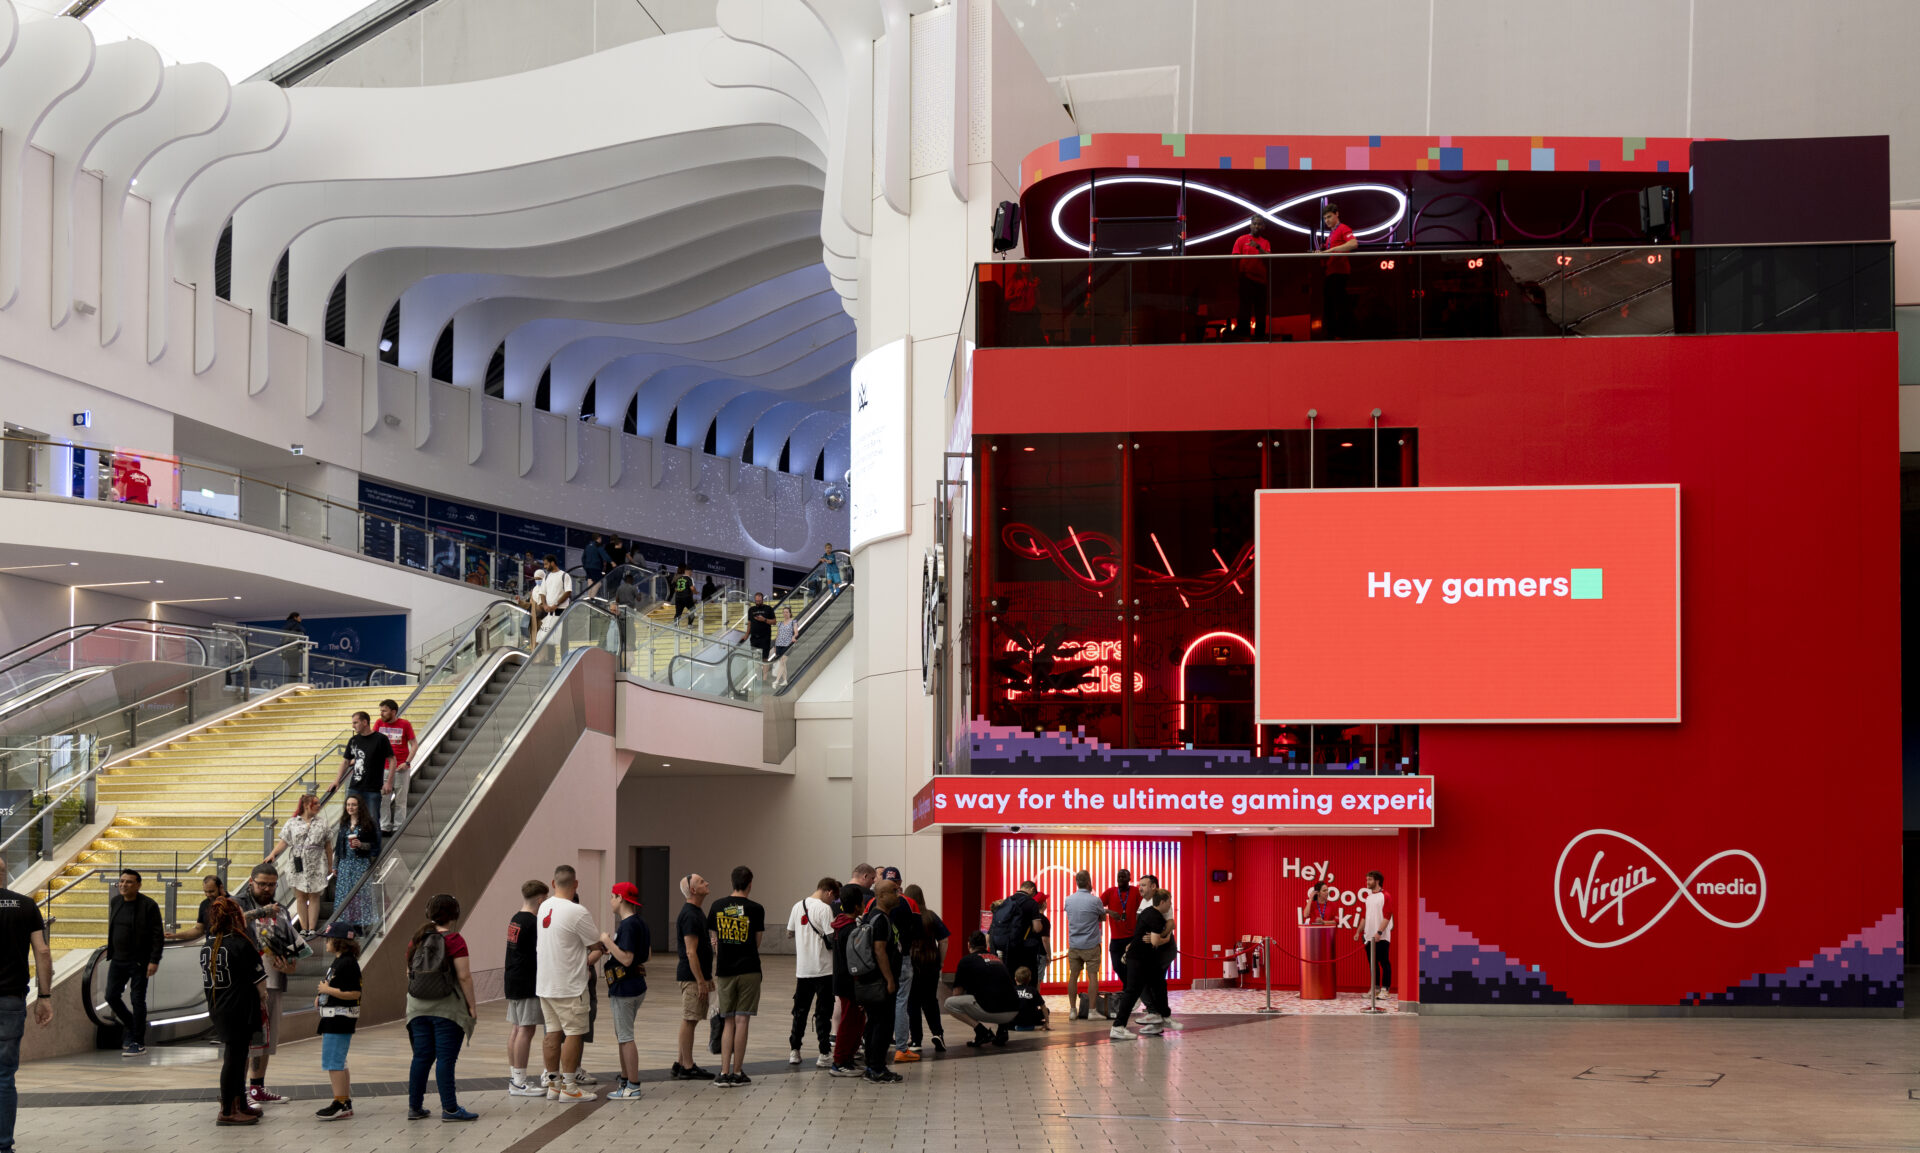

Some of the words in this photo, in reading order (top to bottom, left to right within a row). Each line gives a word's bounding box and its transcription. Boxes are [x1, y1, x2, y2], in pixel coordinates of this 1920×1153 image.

[1380, 260, 1395, 270] 05
[1468, 258, 1484, 269] 06
[1556, 255, 1573, 266] 07
[1368, 571, 1433, 604] Hey
[1442, 576, 1569, 604] gamers
[328, 643, 339, 651] The
[954, 793, 1011, 814] way
[1018, 788, 1056, 809] for
[1062, 788, 1105, 809] the
[1113, 788, 1224, 809] ultimate
[1232, 788, 1333, 815] gaming
[1283, 857, 1335, 883] Hey,
[1570, 850, 1657, 926] Virgin
[1696, 878, 1757, 895] media
[720, 918, 747, 932] WAS
